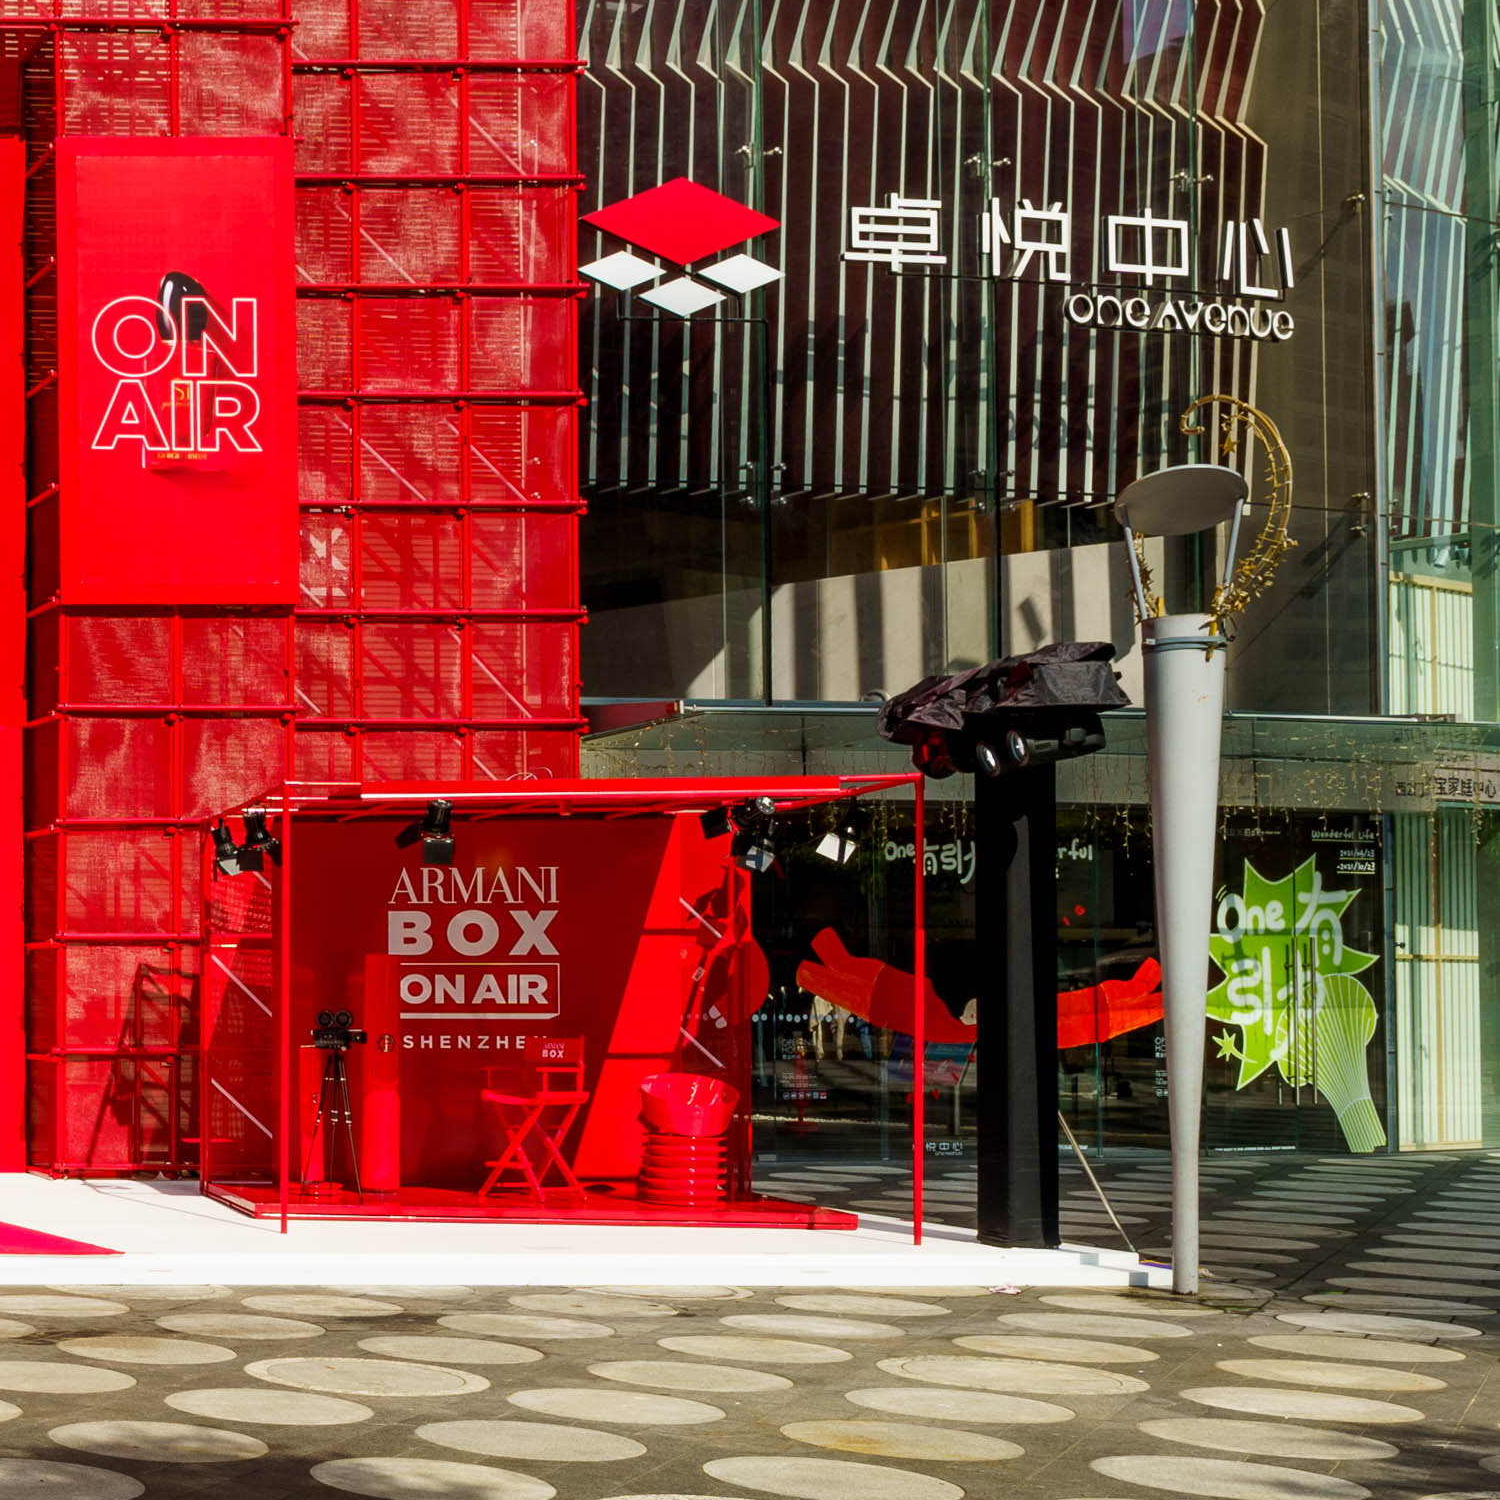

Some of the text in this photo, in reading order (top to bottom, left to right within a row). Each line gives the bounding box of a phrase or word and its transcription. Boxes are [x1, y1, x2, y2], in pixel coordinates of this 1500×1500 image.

[842, 193, 1295, 299] 卓悦中心
[92, 296, 257, 377] ON
[91, 379, 263, 452] AIR
[388, 866, 560, 904] ARMANI
[388, 909, 560, 957] BOX
[400, 973, 549, 1005] ON AIR
[403, 1035, 547, 1049] SHENZHE
[542, 1049, 565, 1059] BOX
